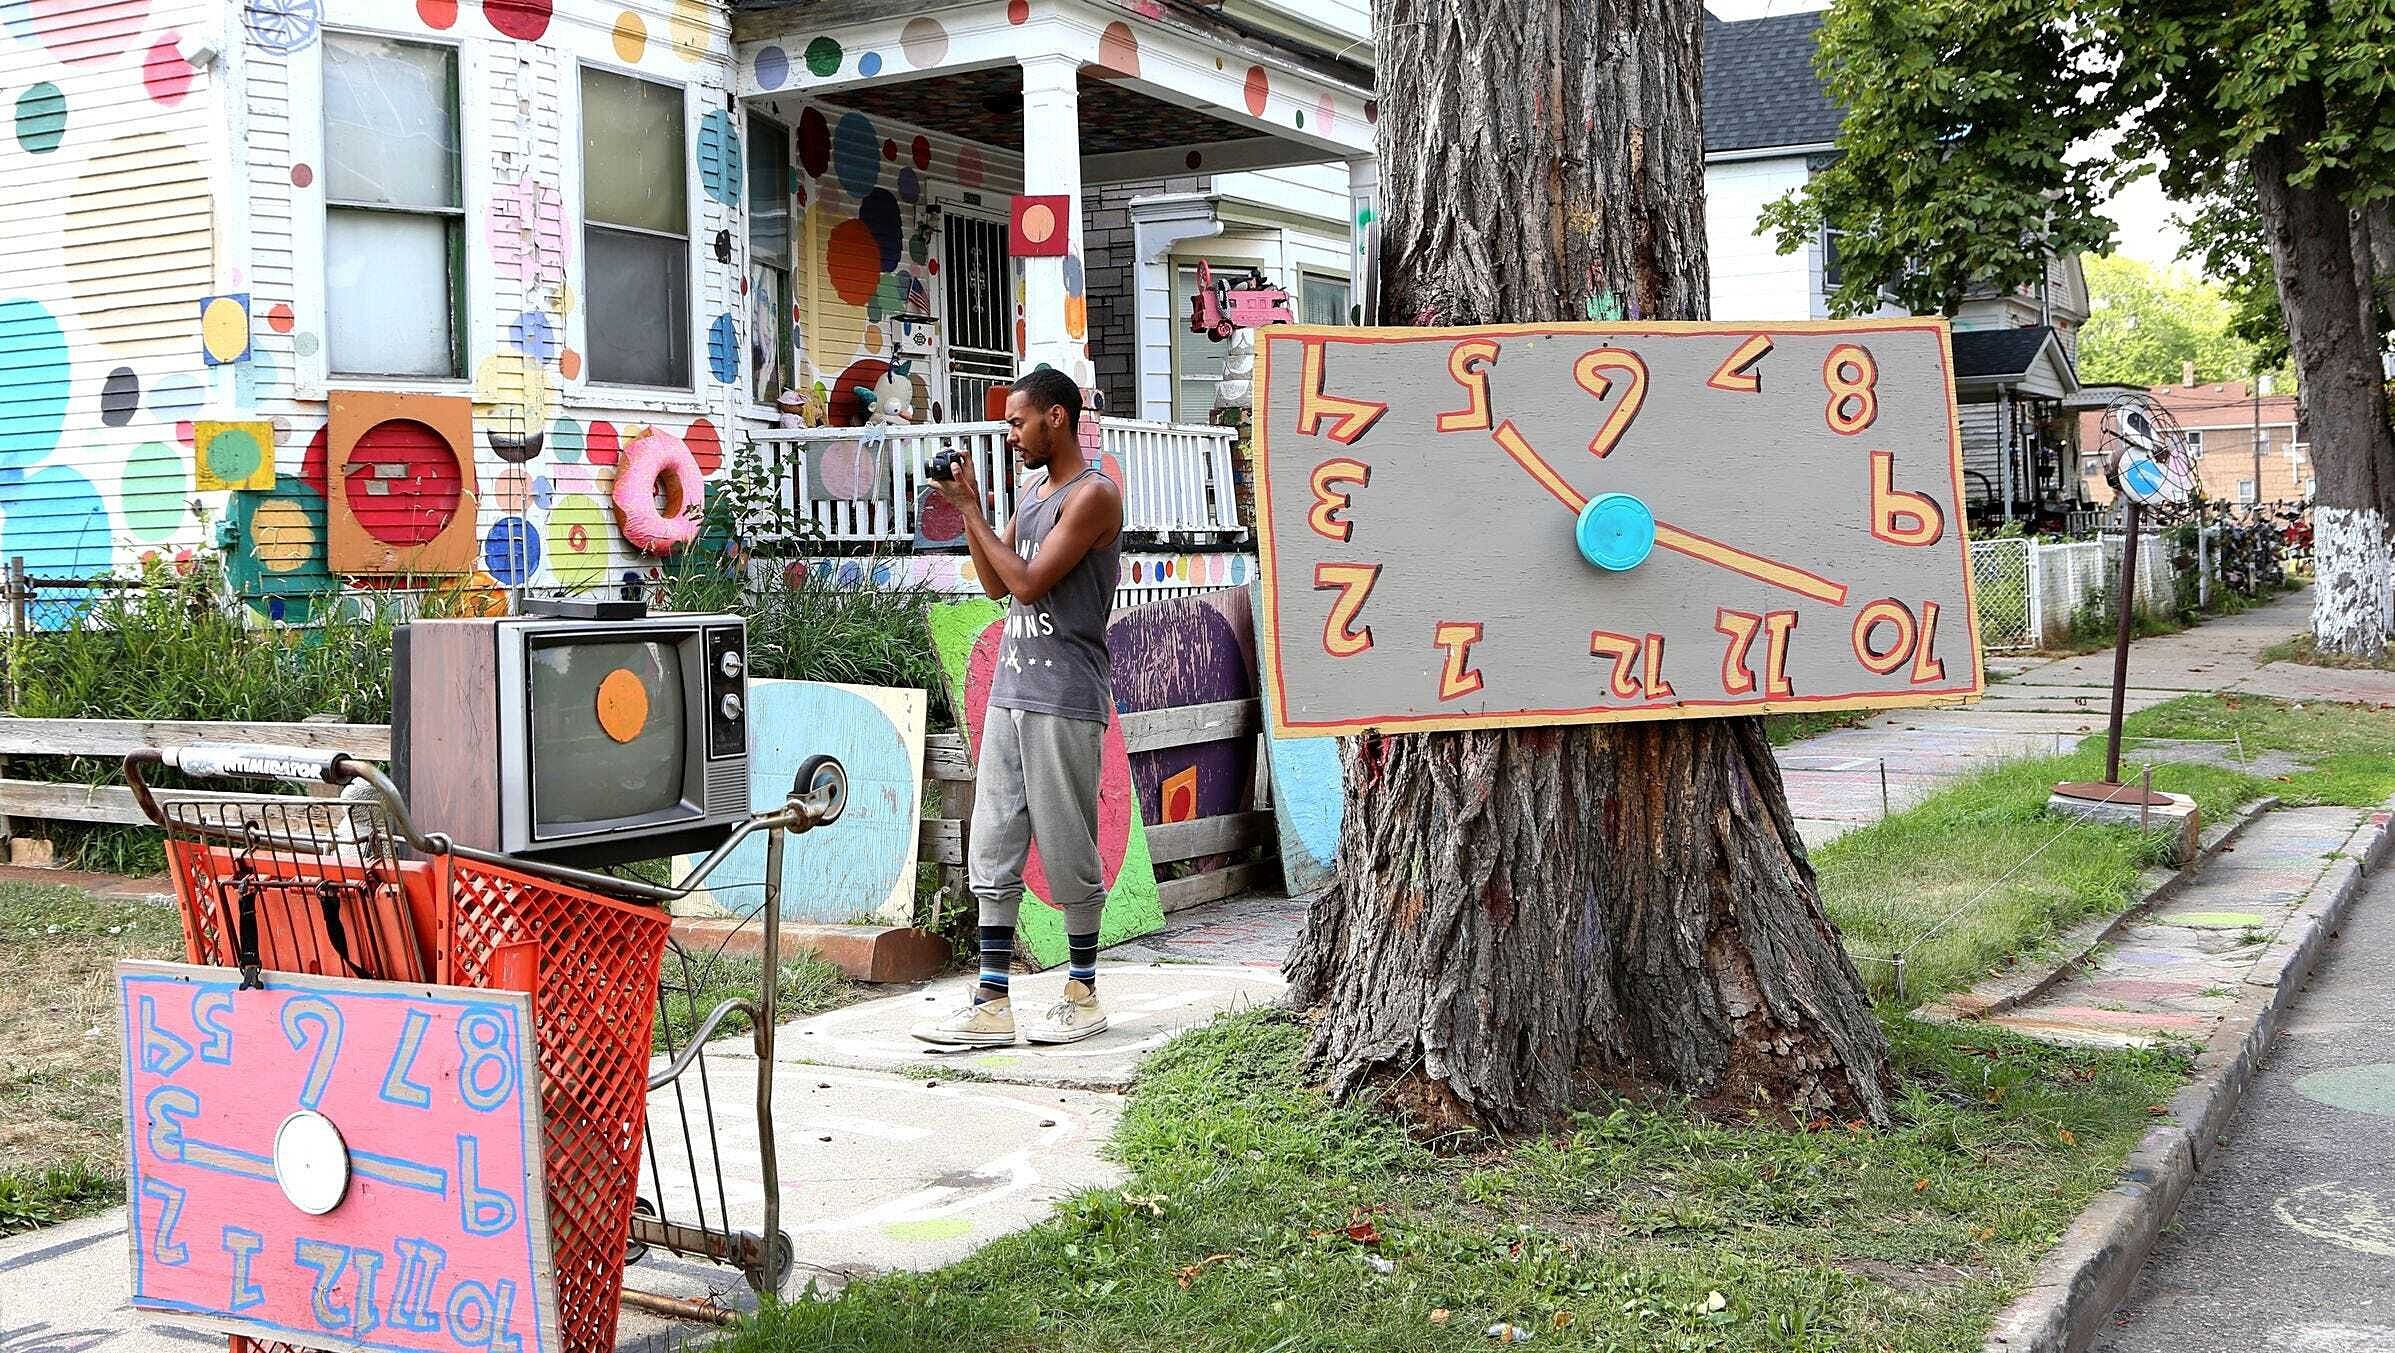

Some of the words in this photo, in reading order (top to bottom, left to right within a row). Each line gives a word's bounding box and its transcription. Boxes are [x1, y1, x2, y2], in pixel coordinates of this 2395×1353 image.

[1298, 337, 1387, 444] 4
[1437, 340, 1500, 432] 5
[1573, 347, 1650, 458] 6
[1707, 333, 1774, 393] 7
[1824, 344, 1878, 435] 8
[1308, 457, 1370, 542] 3
[1870, 450, 1944, 546] 9
[1314, 563, 1383, 657] 2
[1716, 607, 1798, 697] 12
[1852, 598, 1945, 685] 10
[1435, 622, 1484, 701] 1
[1590, 631, 1675, 699] 12
[221, 757, 323, 779] NTIMIDATOR
[139, 995, 194, 1076] 4
[192, 987, 233, 1064] 5
[281, 994, 344, 1109] 6
[379, 1008, 431, 1110] 7
[459, 1004, 516, 1112] 8
[145, 1085, 200, 1162] 3
[142, 1174, 189, 1265] 2
[456, 1133, 517, 1236] 9
[223, 1226, 265, 1311] 1
[295, 1237, 384, 1338] 12
[388, 1237, 447, 1332] 11
[447, 1279, 523, 1353] 10
